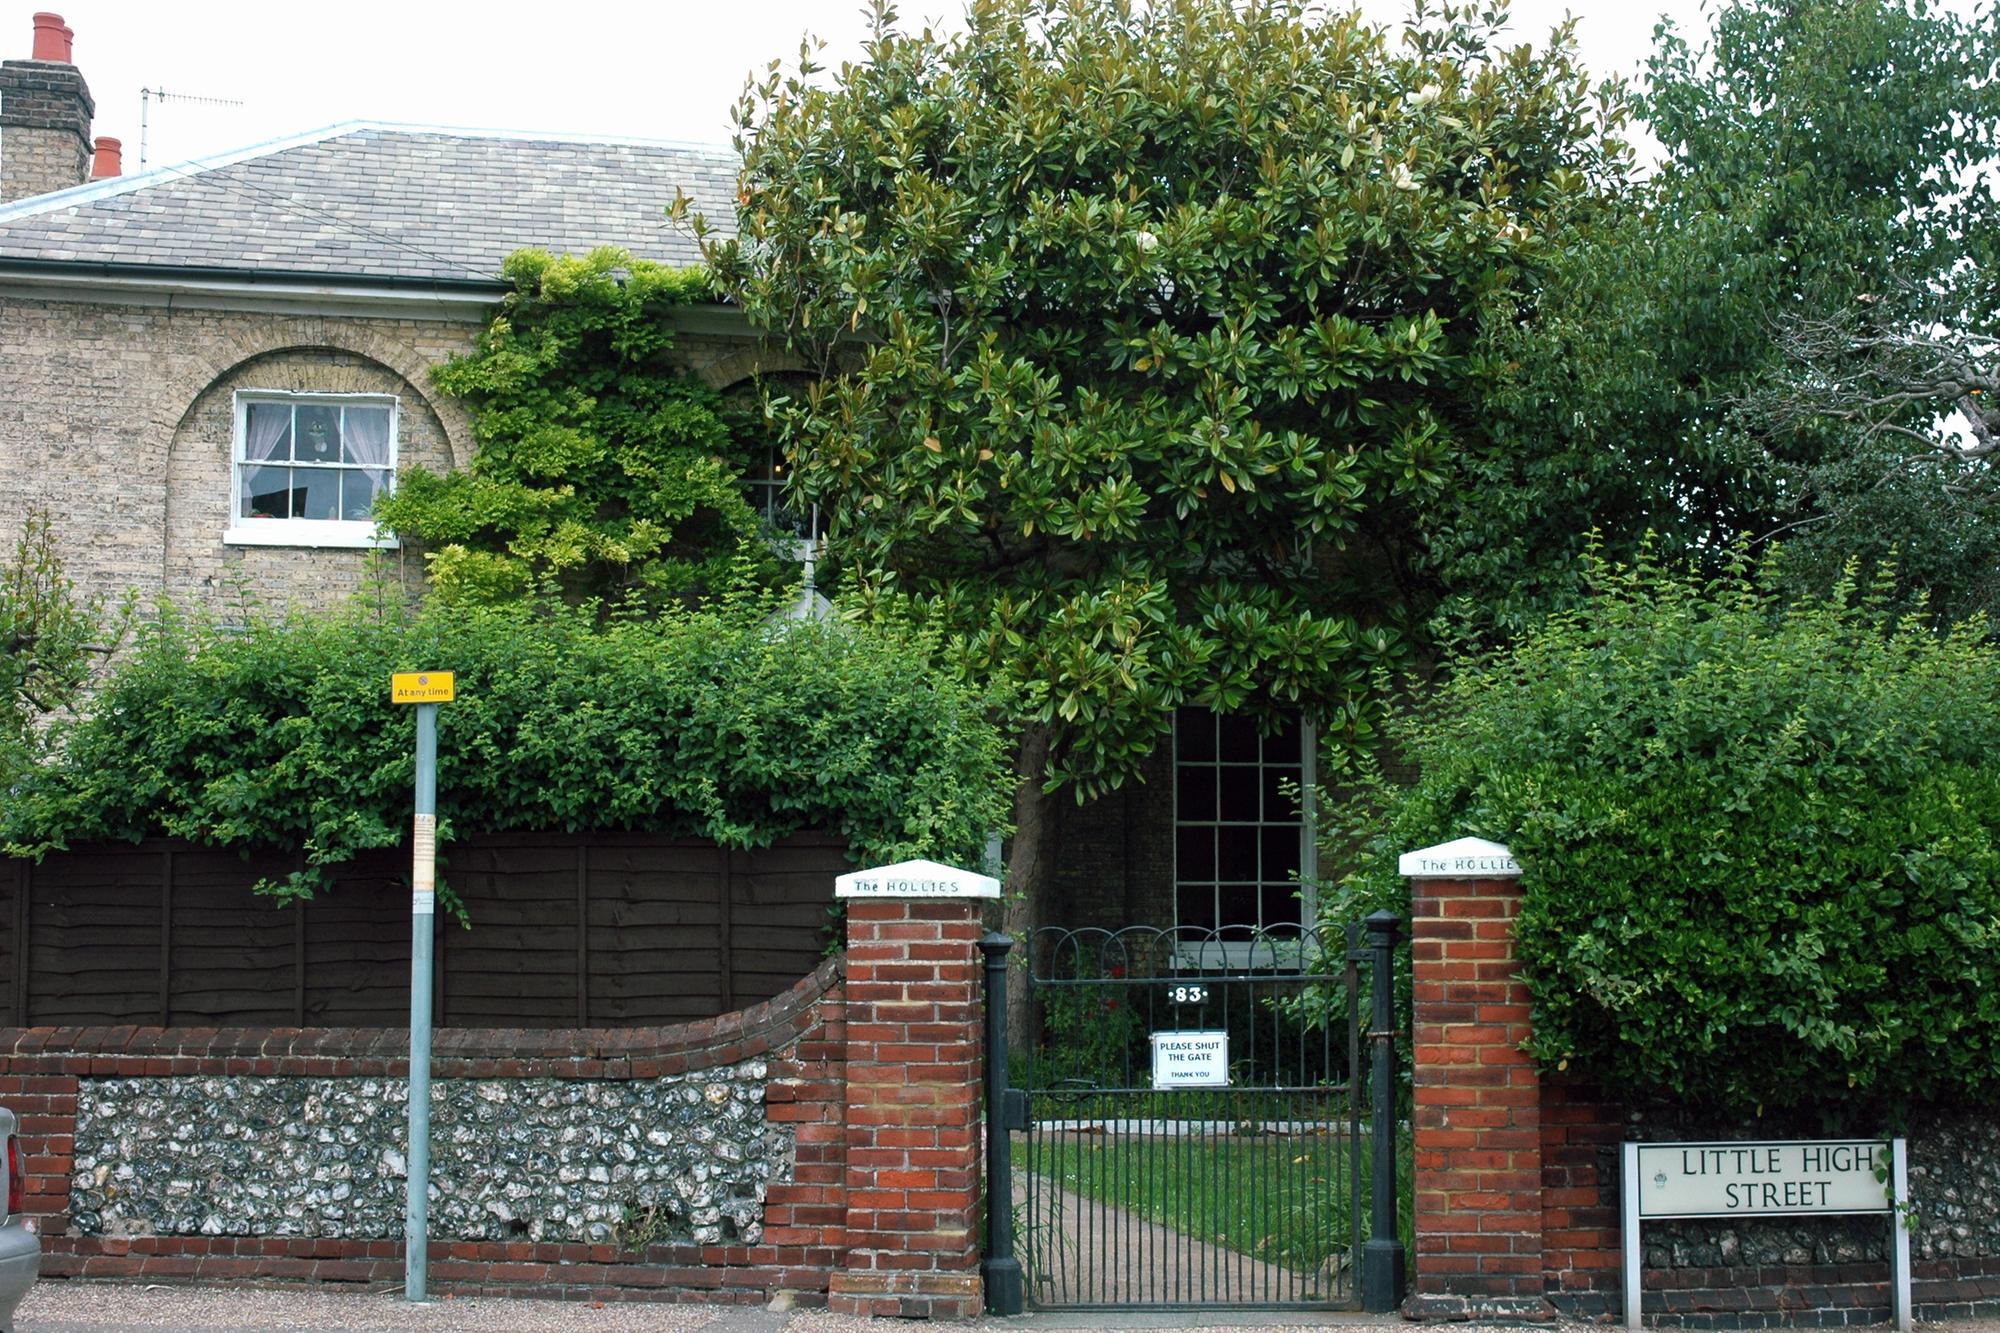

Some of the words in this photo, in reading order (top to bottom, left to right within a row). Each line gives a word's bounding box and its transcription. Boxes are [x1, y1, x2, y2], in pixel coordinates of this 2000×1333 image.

[397, 689, 408, 697] At
[410, 689, 426, 697] any
[428, 688, 449, 696] time
[1420, 860, 1447, 871] The
[1455, 859, 1514, 870] HOLLIE
[855, 881, 878, 892] The
[886, 881, 959, 893] HOLLIES
[1160, 1042, 1193, 1051] PLEASE
[1195, 1042, 1220, 1050] SHUT
[1187, 1053, 1212, 1061] GATE
[1682, 1148, 1781, 1175] LITTLE
[1803, 1147, 1873, 1173] HIGH
[1726, 1181, 1832, 1208] STREET
